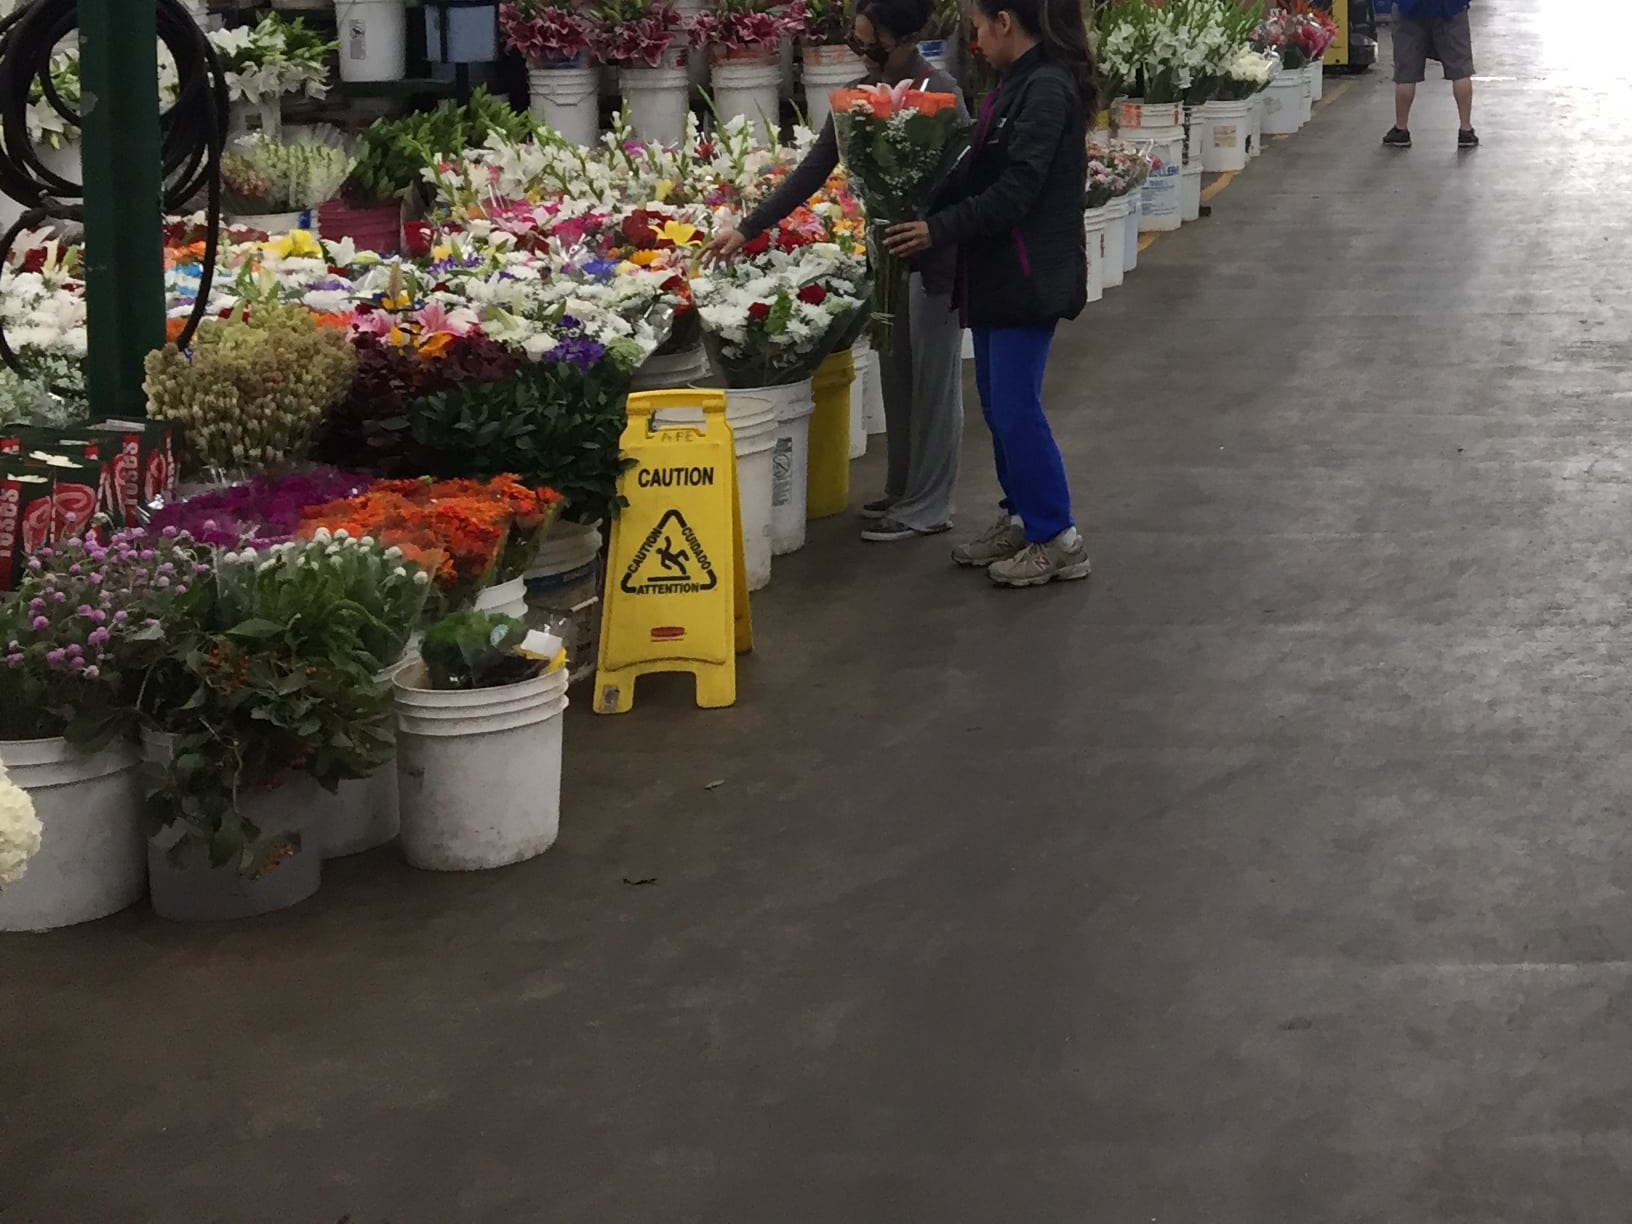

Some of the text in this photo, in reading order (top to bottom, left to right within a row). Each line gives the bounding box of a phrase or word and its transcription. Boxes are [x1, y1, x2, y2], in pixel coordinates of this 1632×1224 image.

[638, 466, 715, 488] CAUTION
[627, 527, 663, 575] CAUTION
[681, 527, 712, 571] CUIDADO
[636, 582, 701, 595] ATTENTION
